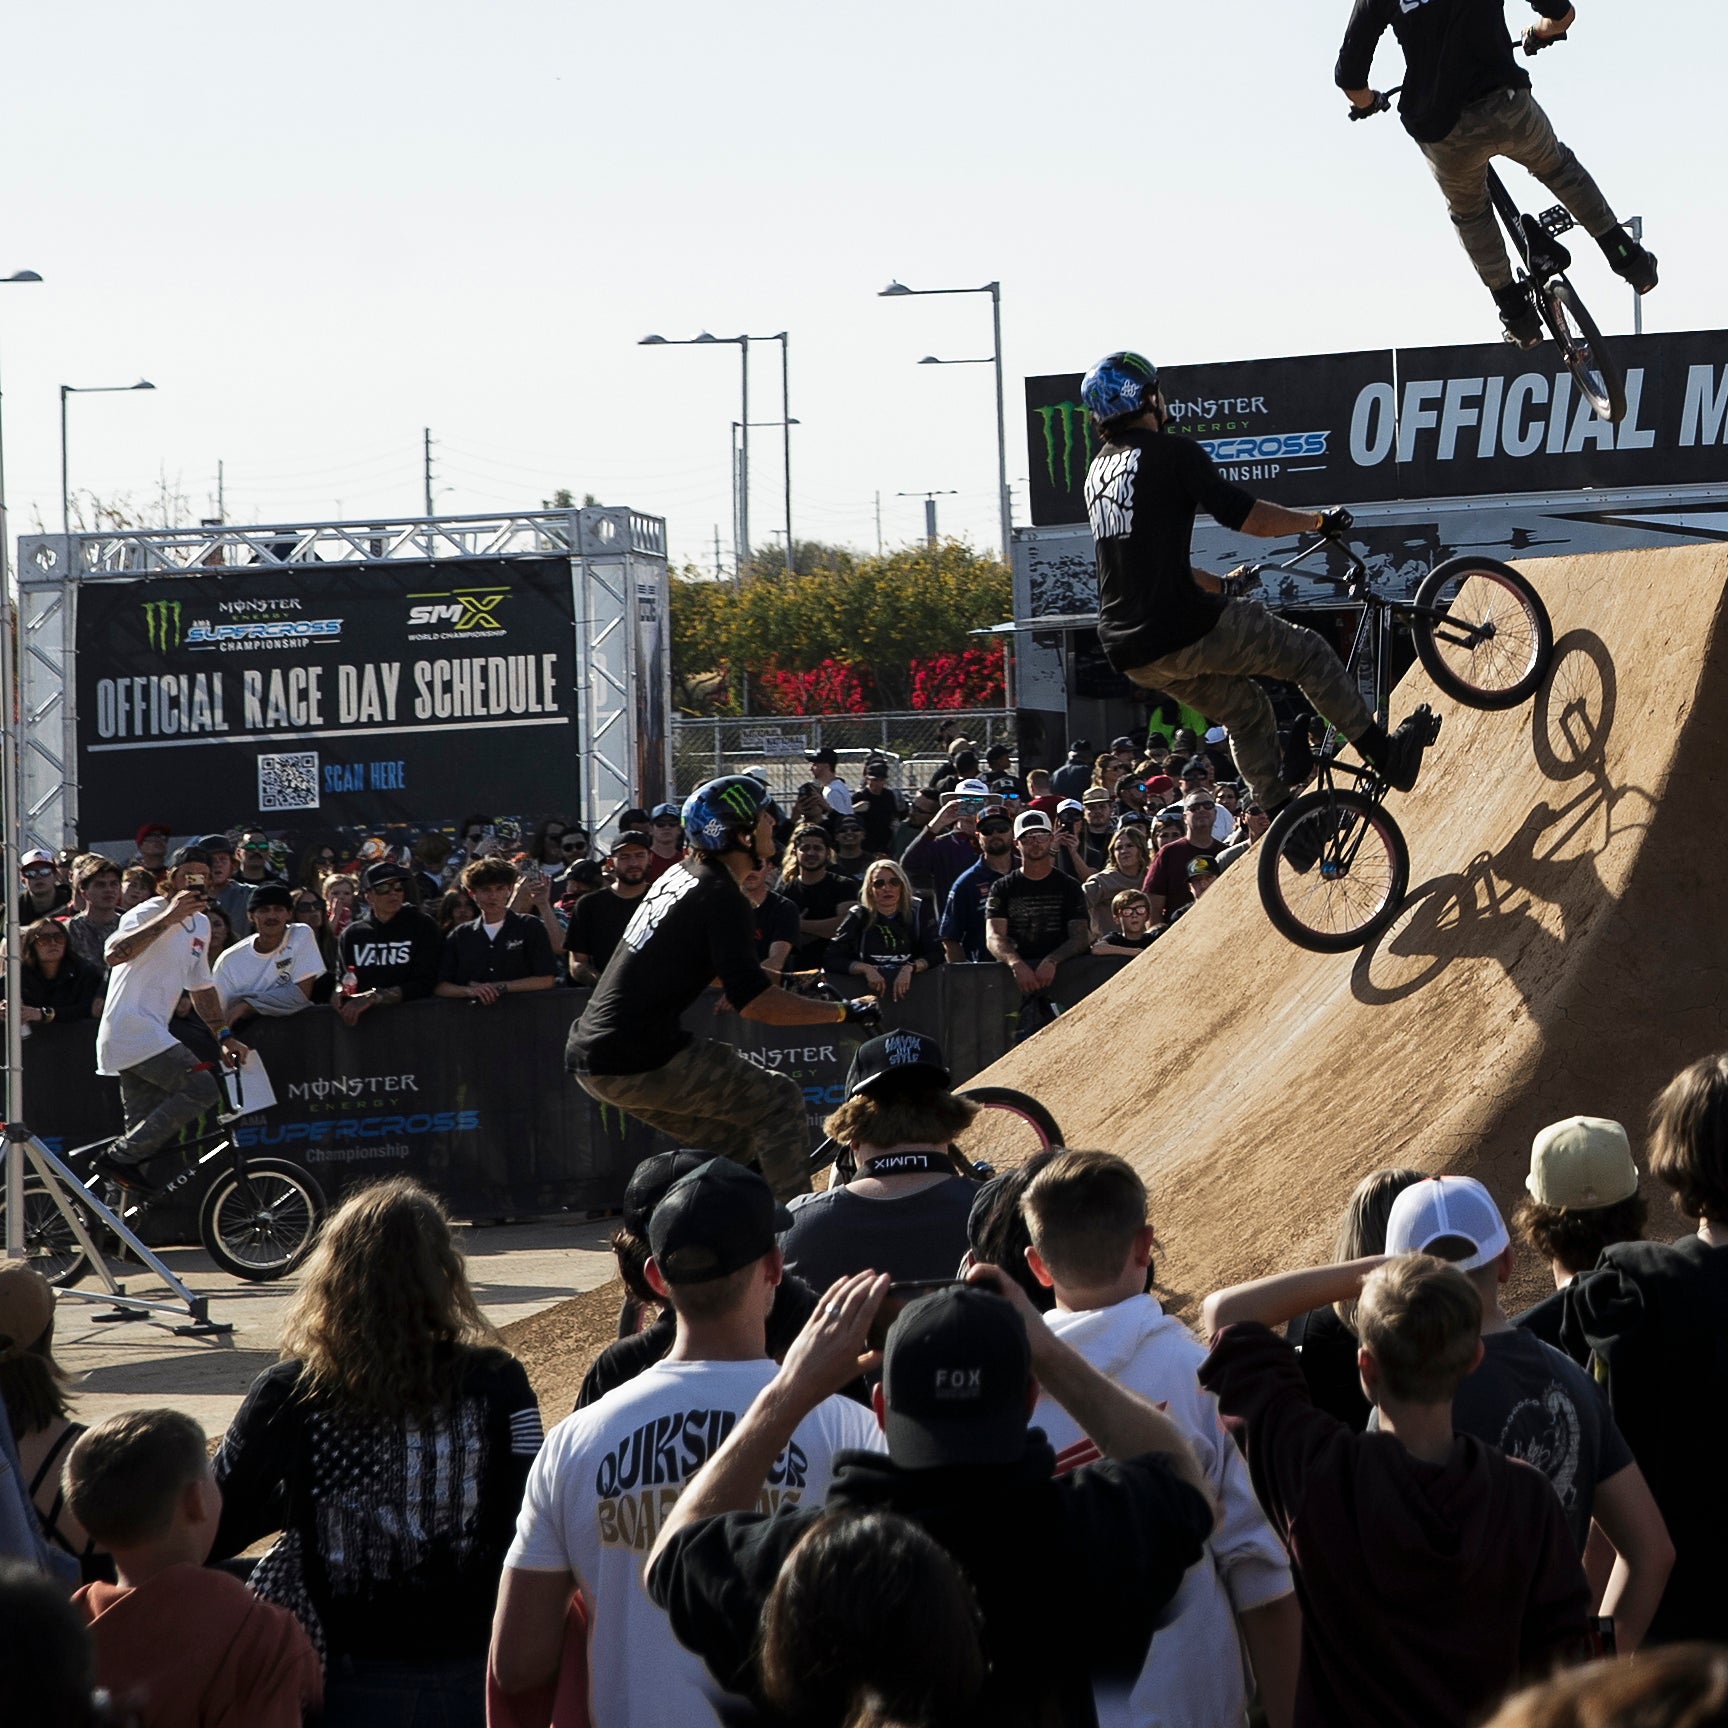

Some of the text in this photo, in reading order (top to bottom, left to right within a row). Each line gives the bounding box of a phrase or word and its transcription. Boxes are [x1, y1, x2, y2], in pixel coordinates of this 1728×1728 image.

[1167, 396, 1268, 423] ONSTER
[1349, 368, 1655, 467] OFFICIAL
[1167, 421, 1250, 434] ENERGY
[1200, 432, 1329, 462] CROSS
[1218, 464, 1280, 481] ONSHIP
[219, 598, 302, 614] MONSTER
[406, 594, 505, 630] SMX
[187, 620, 342, 642] SUPERCROSS
[408, 629, 508, 641] WORLD CHAMPIONSHIP
[219, 638, 310, 652] CHAMPIONSHIP
[97, 653, 559, 738] OFFICIAL RACE DAY SCHEDULE
[324, 760, 405, 793] SCAN HERE
[353, 940, 412, 967] VANS
[288, 1074, 420, 1102] MONSTER
[309, 1097, 399, 1112] ENERGY
[235, 1110, 480, 1148] SUPERCROSS
[305, 1142, 410, 1163] Championship
[874, 1155, 928, 1169] LUMIX
[936, 1368, 981, 1388] FOX
